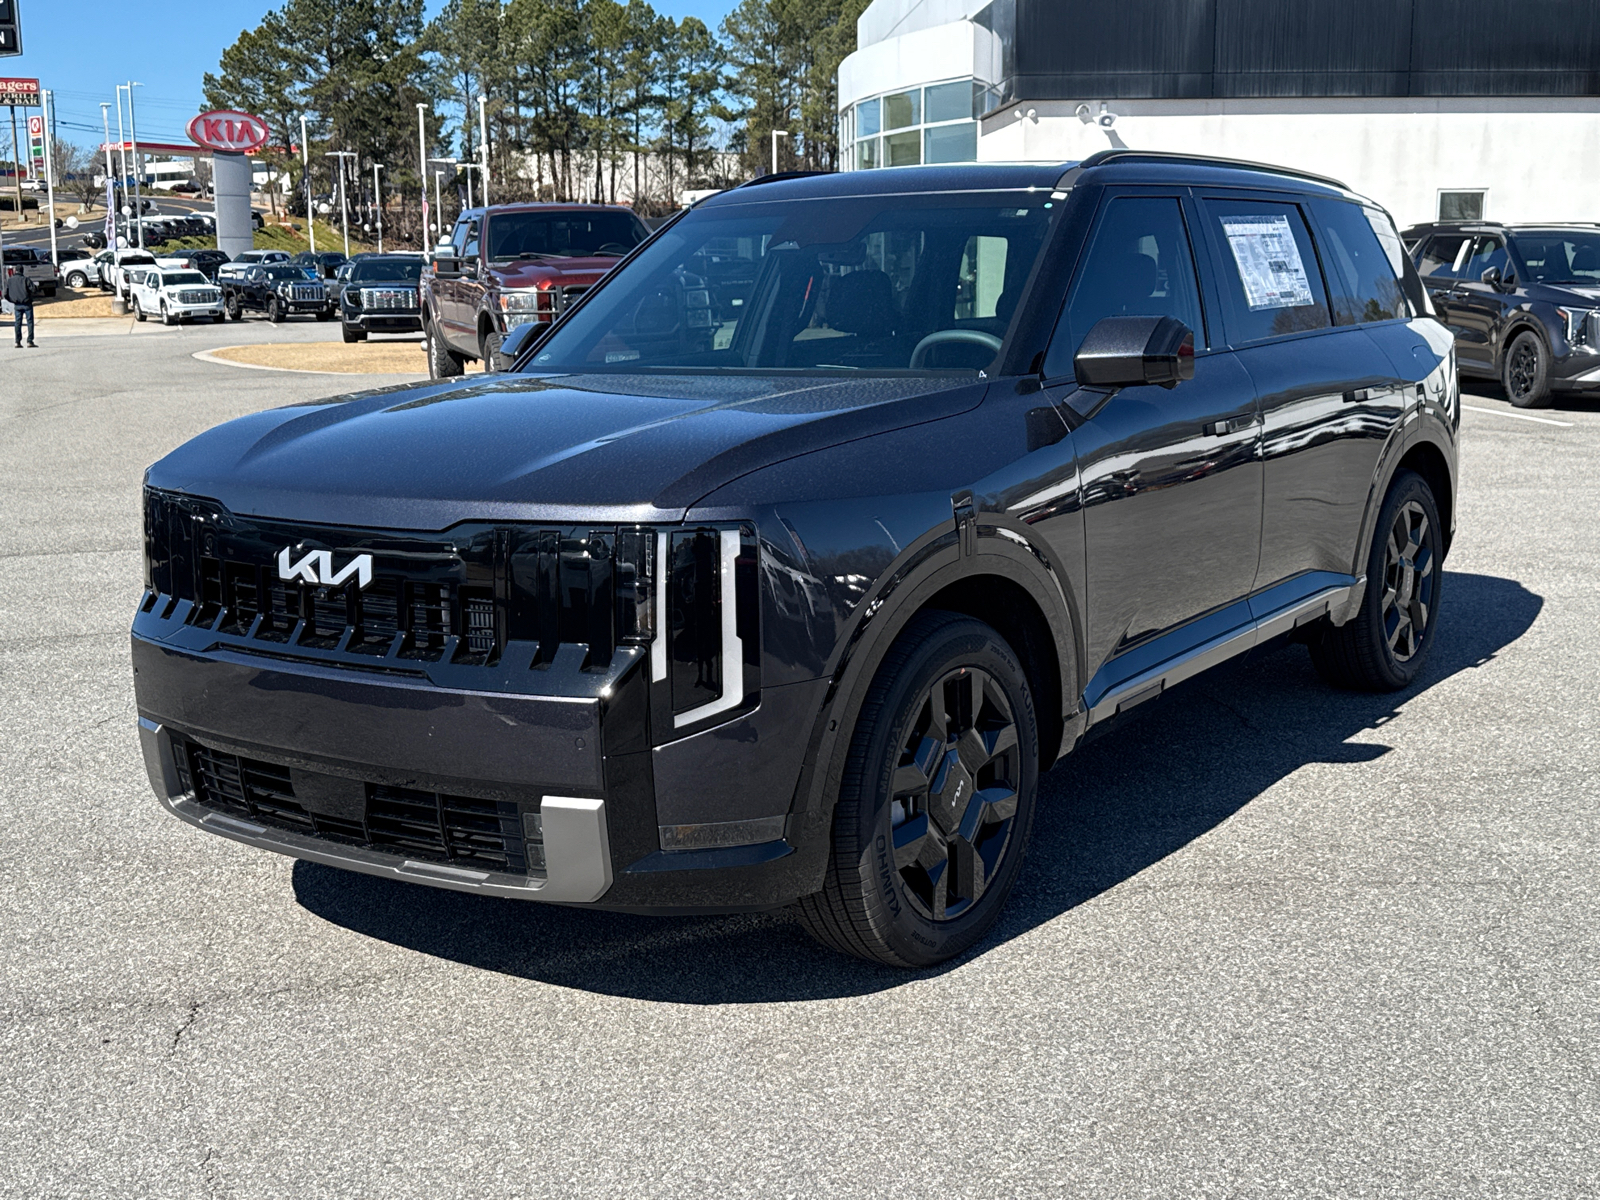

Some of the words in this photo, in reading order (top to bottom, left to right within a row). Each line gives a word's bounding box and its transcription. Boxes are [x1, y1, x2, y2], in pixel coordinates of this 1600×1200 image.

[203, 119, 257, 143] KIA
[278, 546, 373, 590] KIA
[1019, 680, 1038, 758] KUMHO
[951, 779, 964, 808] KIA
[875, 834, 903, 918] KUMHO
[910, 929, 937, 948] OUTSIDE
